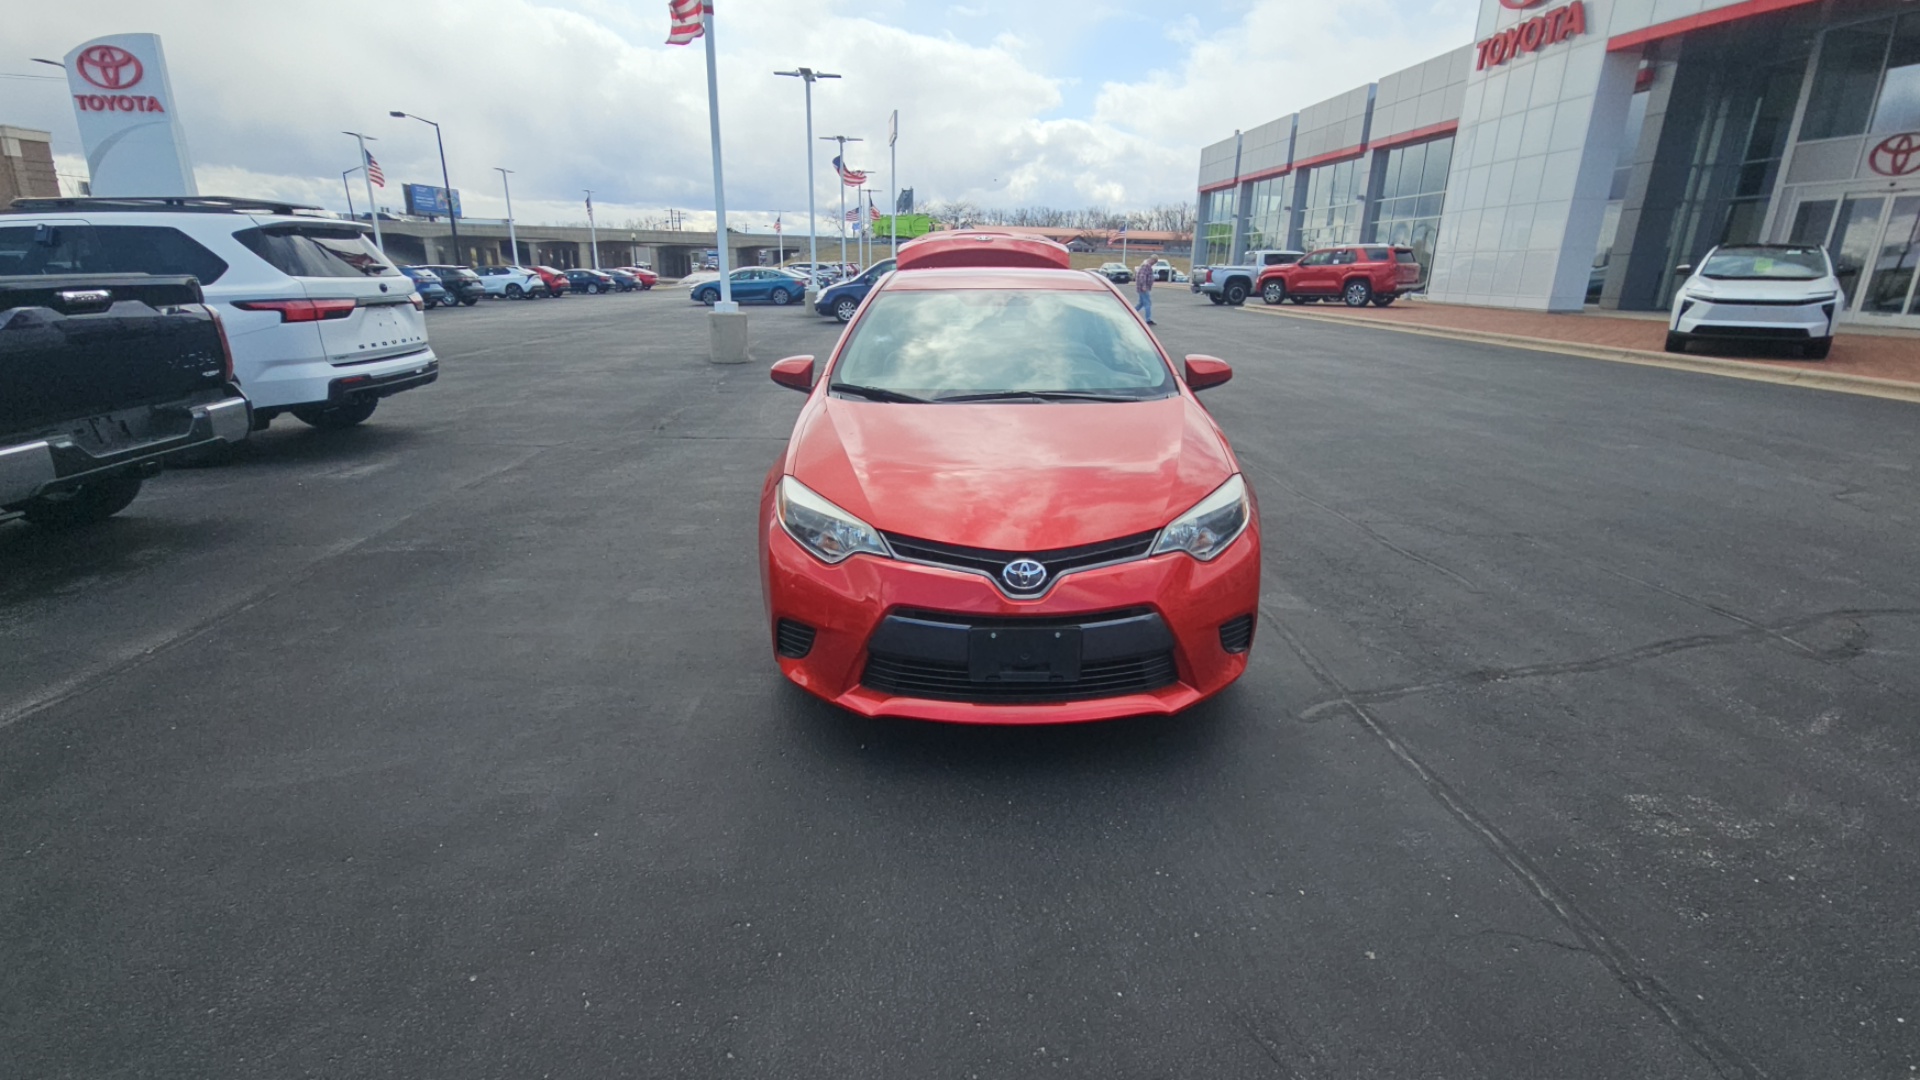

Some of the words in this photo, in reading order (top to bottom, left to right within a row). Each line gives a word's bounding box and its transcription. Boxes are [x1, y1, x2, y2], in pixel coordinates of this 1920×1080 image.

[1476, 1, 1585, 71] TOYOTA
[73, 94, 165, 112] TOYOTA
[358, 336, 421, 349] SEQUOIA
